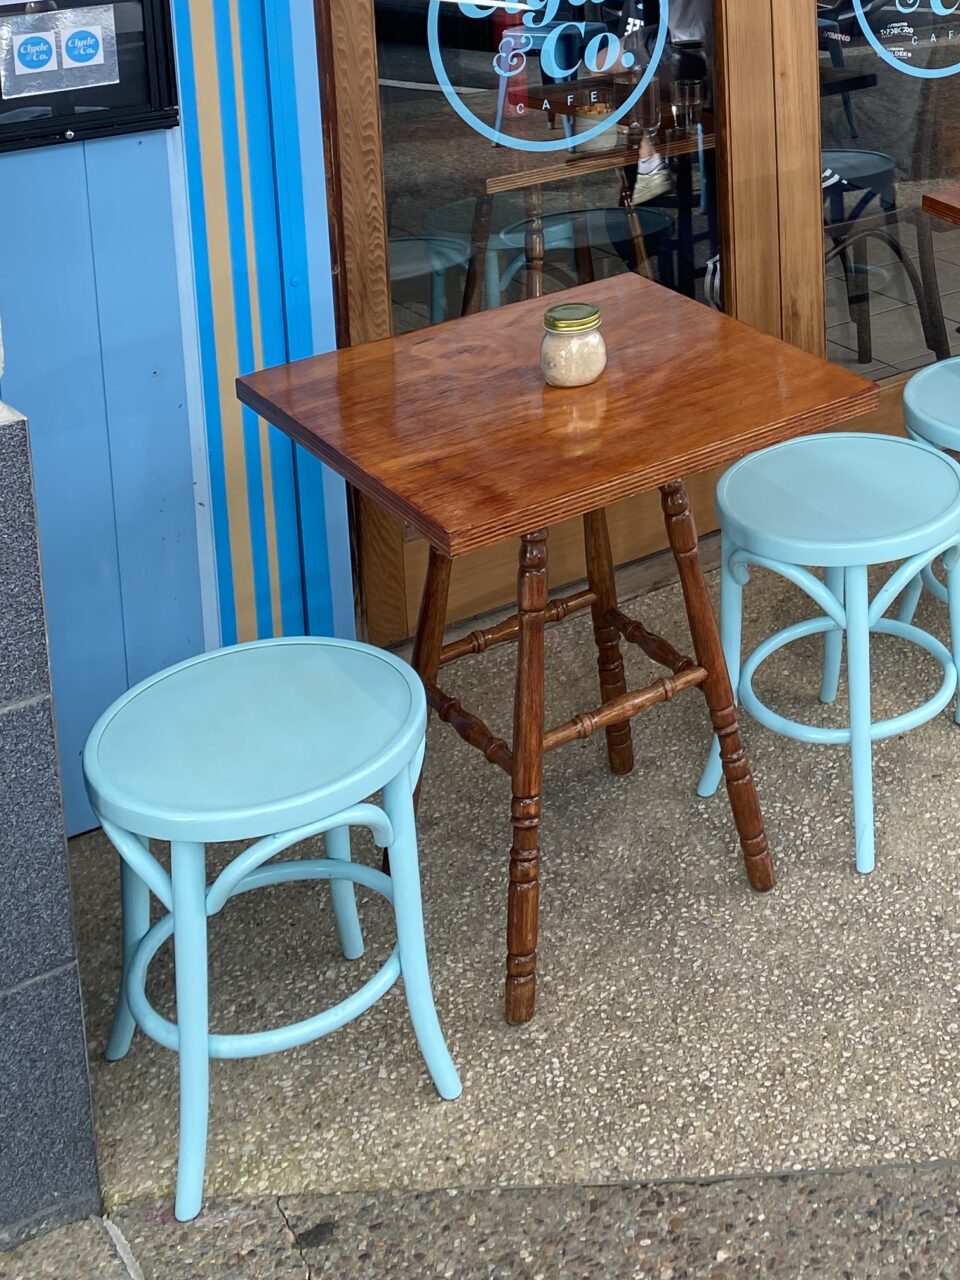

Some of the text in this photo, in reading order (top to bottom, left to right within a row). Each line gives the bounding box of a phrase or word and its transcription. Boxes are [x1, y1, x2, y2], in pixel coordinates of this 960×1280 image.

[20, 42, 49, 54] Clyde
[68, 36, 96, 48] Clyde
[80, 46, 96, 55] Co.
[493, 21, 635, 79] & Co.
[33, 53, 49, 61] Co.
[516, 91, 598, 115] CAFE
